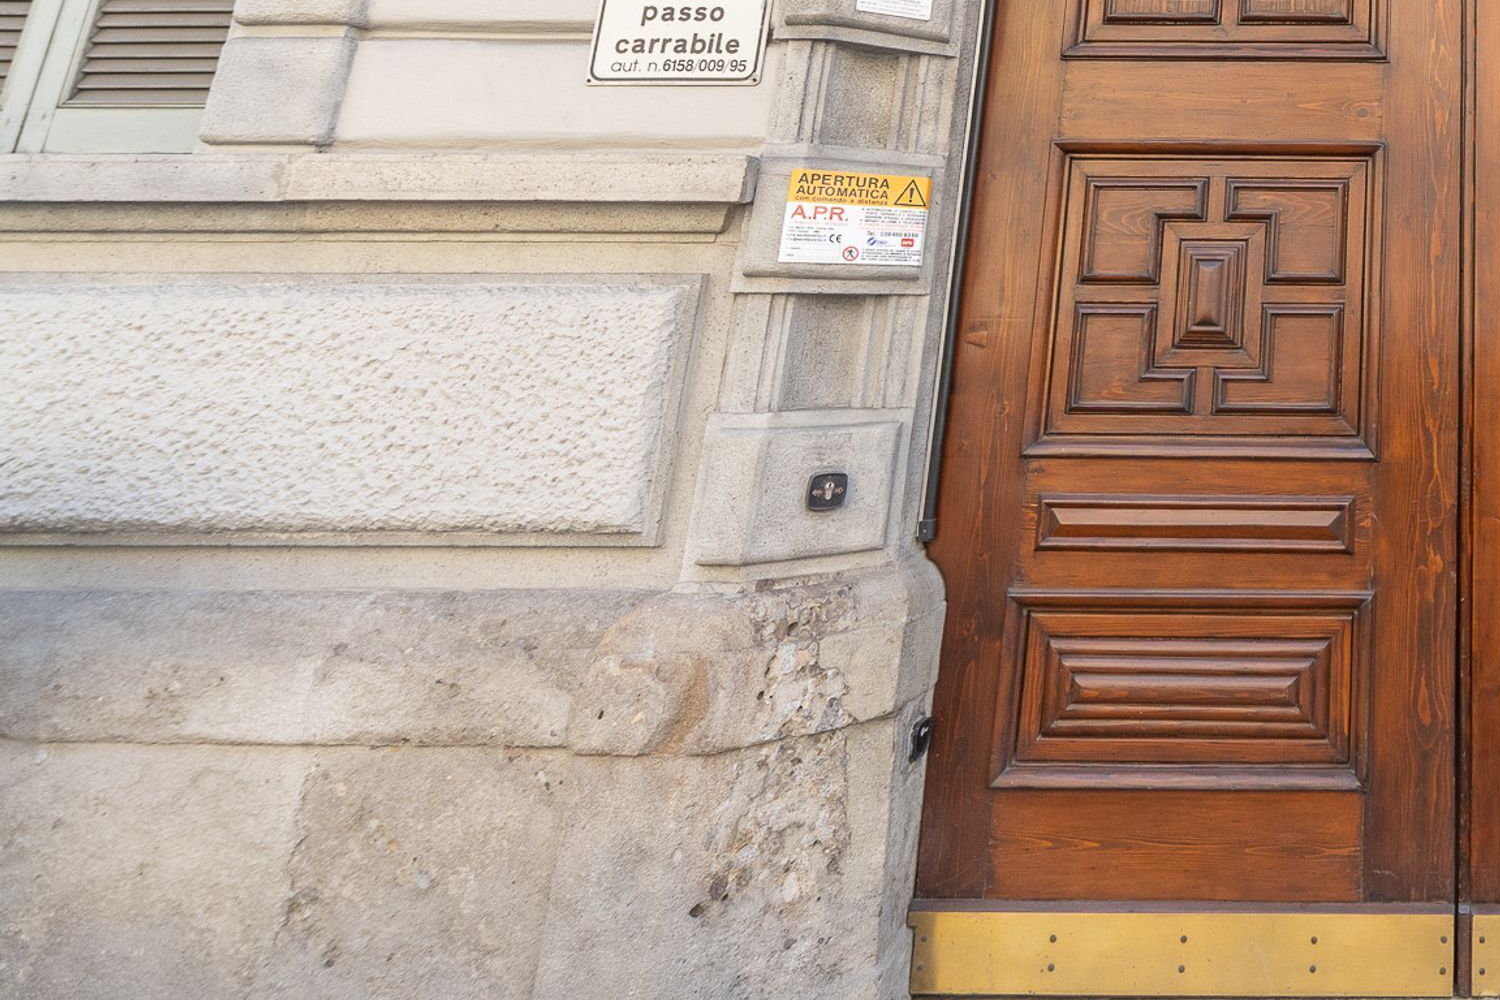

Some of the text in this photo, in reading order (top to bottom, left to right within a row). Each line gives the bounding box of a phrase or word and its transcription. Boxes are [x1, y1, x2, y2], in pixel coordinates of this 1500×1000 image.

[640, 5, 725, 27] passo
[614, 33, 741, 54] carrabile
[610, 58, 641, 72] aut.
[798, 172, 890, 189] APERTURA
[796, 185, 889, 199] AUTOMATICA
[857, 198, 888, 206] distanza
[790, 204, 849, 221] A.P.R.
